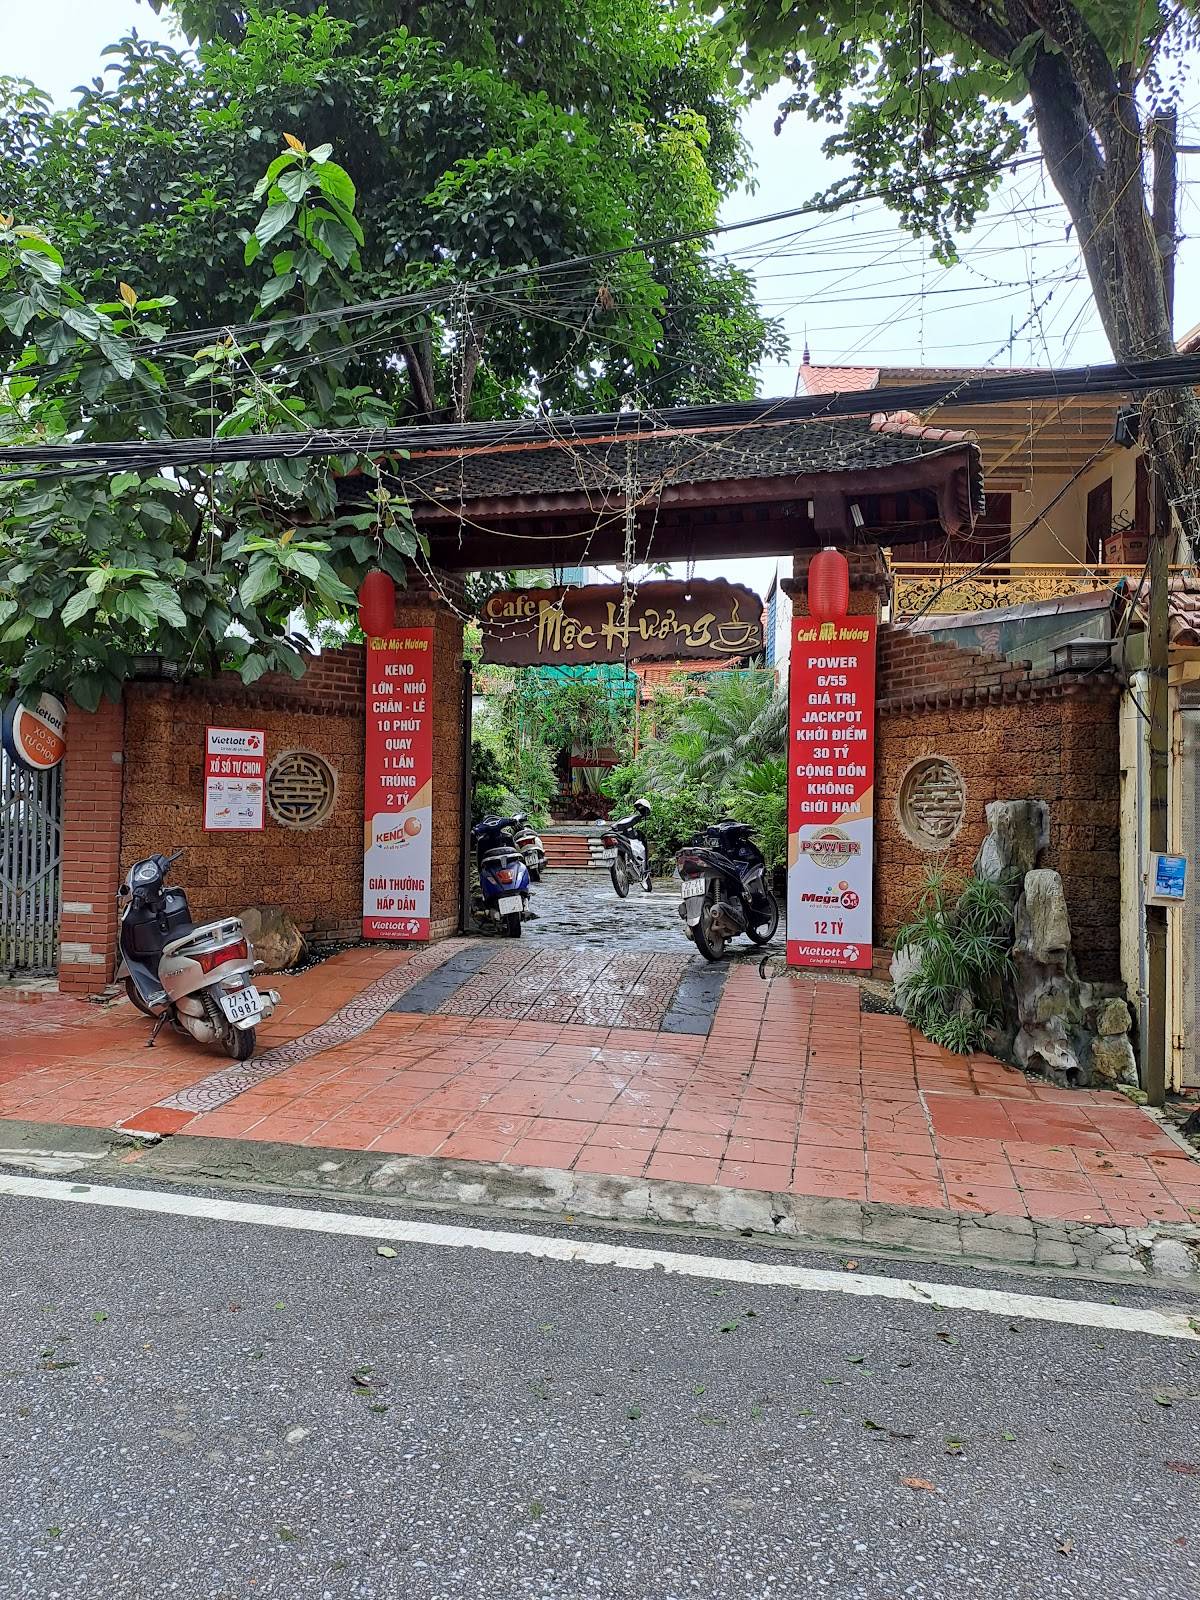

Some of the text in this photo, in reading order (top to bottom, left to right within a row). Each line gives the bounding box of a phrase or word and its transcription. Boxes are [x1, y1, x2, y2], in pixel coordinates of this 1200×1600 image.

[486, 595, 536, 618] Cafe
[537, 599, 598, 653] Mộc
[797, 628, 817, 642] Café
[838, 628, 870, 643] Hương
[385, 664, 414, 675] KENO
[808, 657, 857, 668] POWER
[372, 681, 393, 694] LỚN
[404, 680, 427, 694] NHỎ
[817, 675, 847, 687] 6/55
[373, 698, 403, 713] CHẴN
[413, 698, 426, 712] LẺ
[808, 691, 856, 707] GIÁ TRỊ
[35, 706, 62, 729] ietlott
[377, 717, 422, 731] 10 PHÚT
[802, 711, 862, 723] JACKPOT
[796, 725, 867, 740] KHỞI ĐIỂM
[211, 736, 246, 746] Vietlott
[385, 738, 413, 750] QUAY
[813, 744, 849, 759] 30 TỶ
[210, 756, 261, 776] XỔ SỐ TỰ CHỌN
[384, 753, 414, 768] 1 LẦN
[796, 762, 866, 779] CỘNG DỒN
[380, 774, 416, 787] TRÚNG
[807, 781, 855, 795] KHÔNG
[386, 790, 409, 805] 2 TỶ
[801, 799, 828, 813] GIỚI
[376, 827, 404, 844] KENO
[801, 841, 860, 854] POWER
[369, 875, 425, 891] GIẢI THƯỞNG
[376, 894, 416, 911] HẤP DẪN
[801, 893, 839, 905] Mega
[371, 920, 405, 930] Vietlott
[814, 917, 844, 935] 12 TỶ
[799, 946, 841, 957] Vietlott
[231, 1000, 259, 1019] 0982
